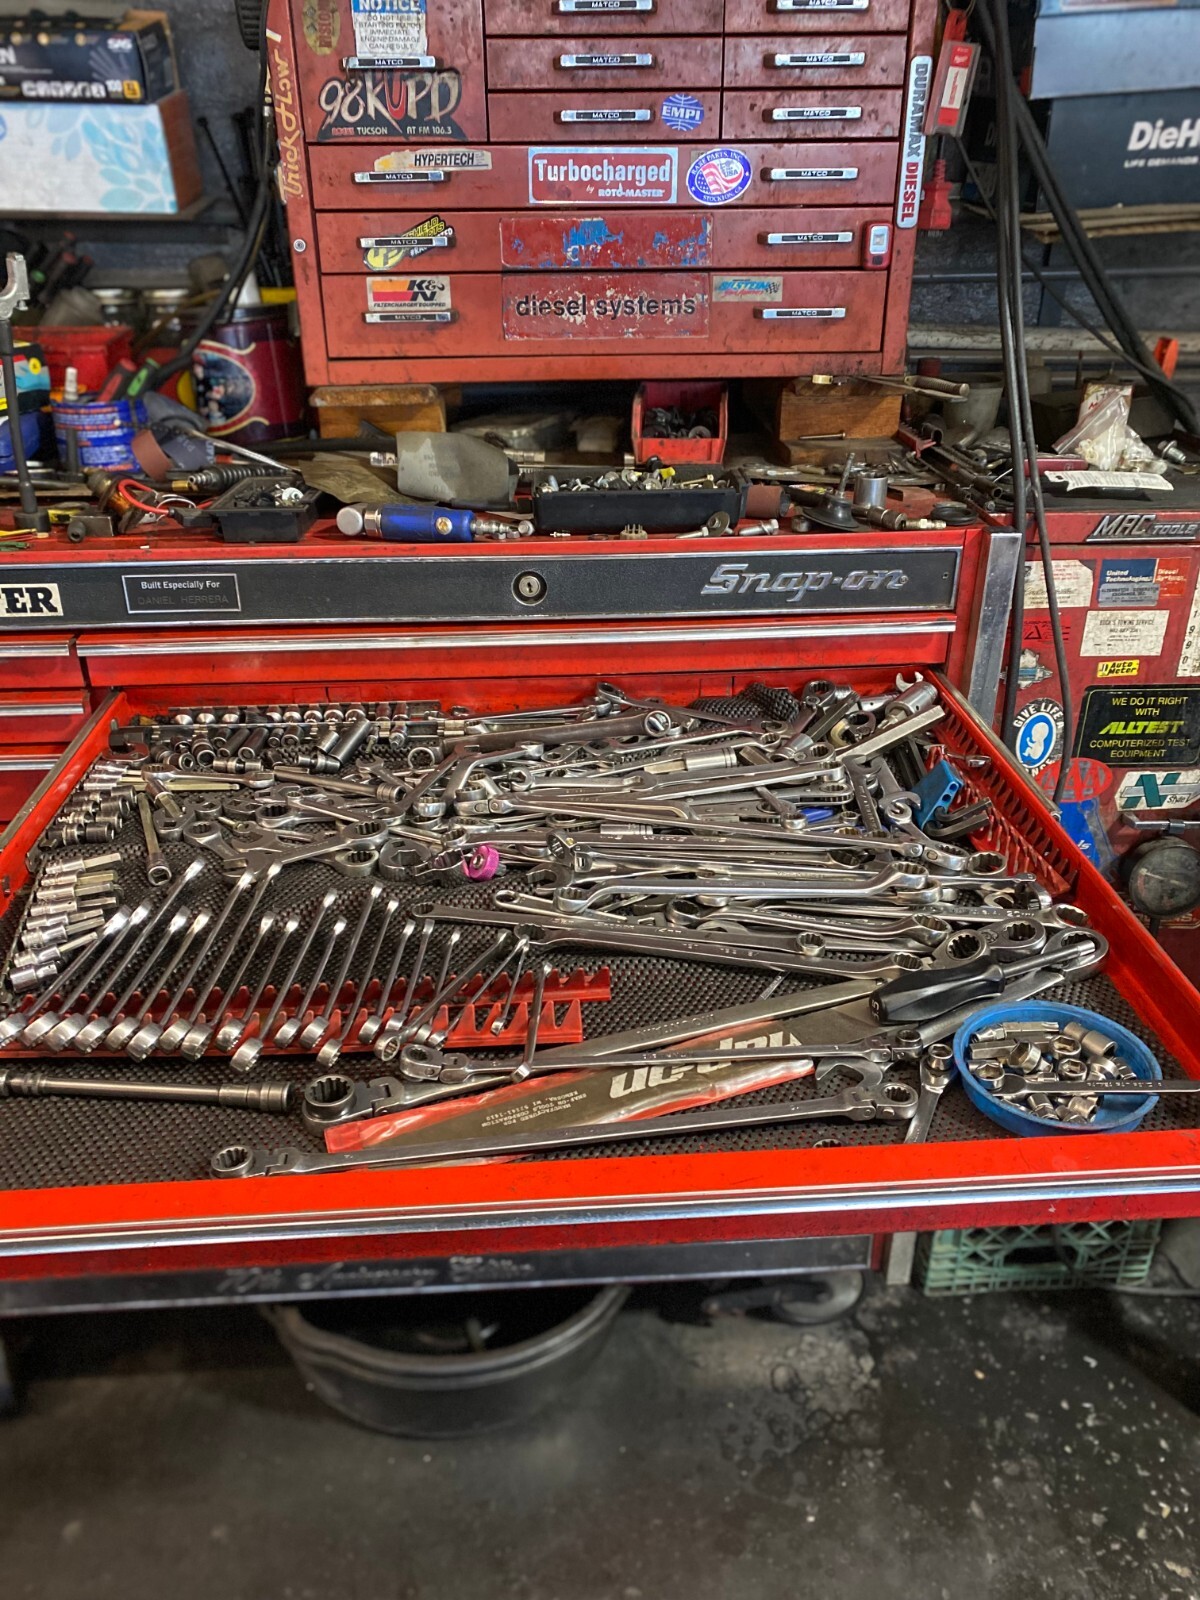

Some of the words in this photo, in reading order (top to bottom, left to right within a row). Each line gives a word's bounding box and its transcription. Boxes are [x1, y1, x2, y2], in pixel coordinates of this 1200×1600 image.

[358, 0, 421, 11] NOTICE
[662, 105, 701, 121] EMPI
[907, 63, 929, 158] DURAMAX
[357, 126, 388, 135] TUCSON
[418, 126, 430, 135] FM
[432, 126, 452, 135] 106.3
[414, 153, 475, 167] HYPERTECH
[691, 157, 707, 175] RARE
[534, 159, 671, 187] Turbocharged
[586, 184, 594, 194] by
[598, 188, 665, 197] ROTO-MASTER
[901, 161, 919, 223] DIESEL
[407, 279, 445, 302] K&N
[516, 294, 587, 316] diesel
[596, 296, 696, 320] systems
[1093, 514, 1156, 536] MAC
[141, 581, 161, 589] Built
[163, 580, 204, 590] Especially
[206, 580, 220, 588] For
[701, 563, 904, 602] Snap-on
[180, 595, 229, 604] HERRERA
[1108, 667, 1136, 675] Meter
[1111, 661, 1133, 669] Auto
[1112, 697, 1127, 705] WE
[1130, 697, 1145, 705] DO
[1146, 697, 1156, 705] IT
[1158, 696, 1188, 705] RIGHT
[1013, 705, 1037, 727] GIVE
[1040, 703, 1064, 720] LIFE
[1135, 708, 1160, 716] WITH
[1098, 721, 1185, 735] ALLTEST
[1089, 739, 1165, 748] COMPUTERIZED
[1168, 738, 1190, 747] TEST
[1110, 749, 1167, 758] EQUIPMENT
[520, 1103, 571, 1121] MANUFACTURED
[532, 1102, 554, 1112] TOOLS
[481, 1110, 529, 1127] CORPORATION
